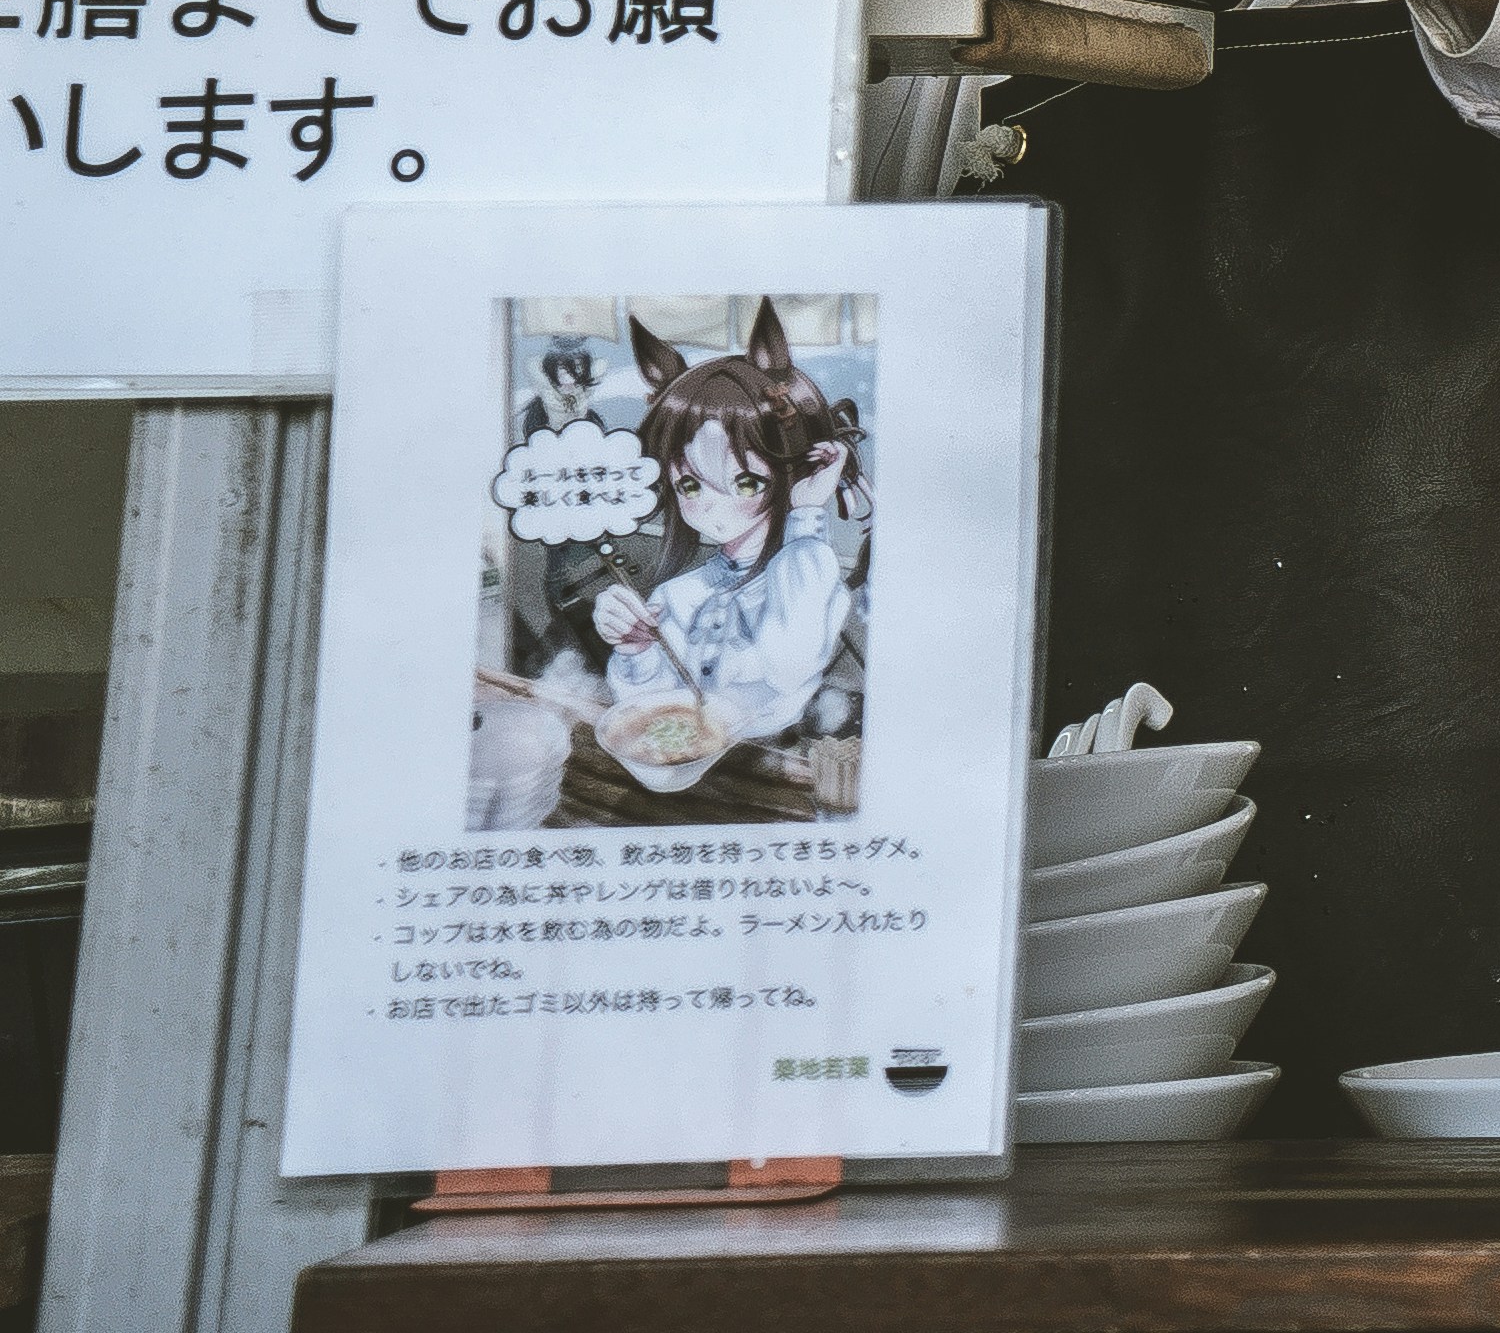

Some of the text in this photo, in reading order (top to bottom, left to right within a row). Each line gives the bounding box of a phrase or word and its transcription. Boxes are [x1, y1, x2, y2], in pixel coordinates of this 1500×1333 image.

[521, 465, 643, 484] ルールを守って
[390, 957, 525, 984] しないでね。
